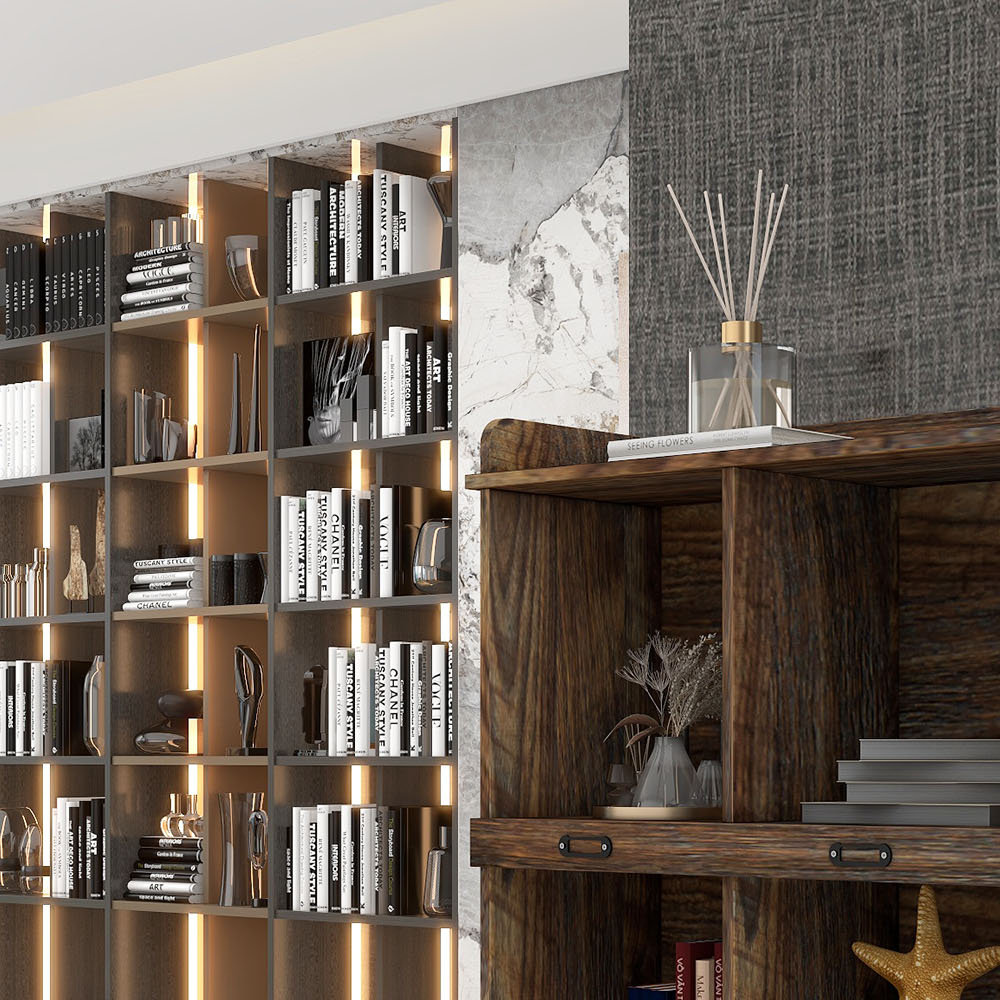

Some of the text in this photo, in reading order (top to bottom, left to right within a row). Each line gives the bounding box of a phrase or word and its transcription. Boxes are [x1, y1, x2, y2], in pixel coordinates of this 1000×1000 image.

[329, 187, 337, 277] ARCHITECTURE
[134, 243, 183, 259] ARCHITECTURE
[132, 261, 163, 272] MODERN
[433, 357, 441, 383] ART
[627, 436, 694, 451] SEEING FLOWERS
[136, 601, 173, 610] CHANEL
[346, 664, 354, 750] TUSCANY STYLE
[90, 832, 98, 856] ART
[149, 883, 165, 891] ART
